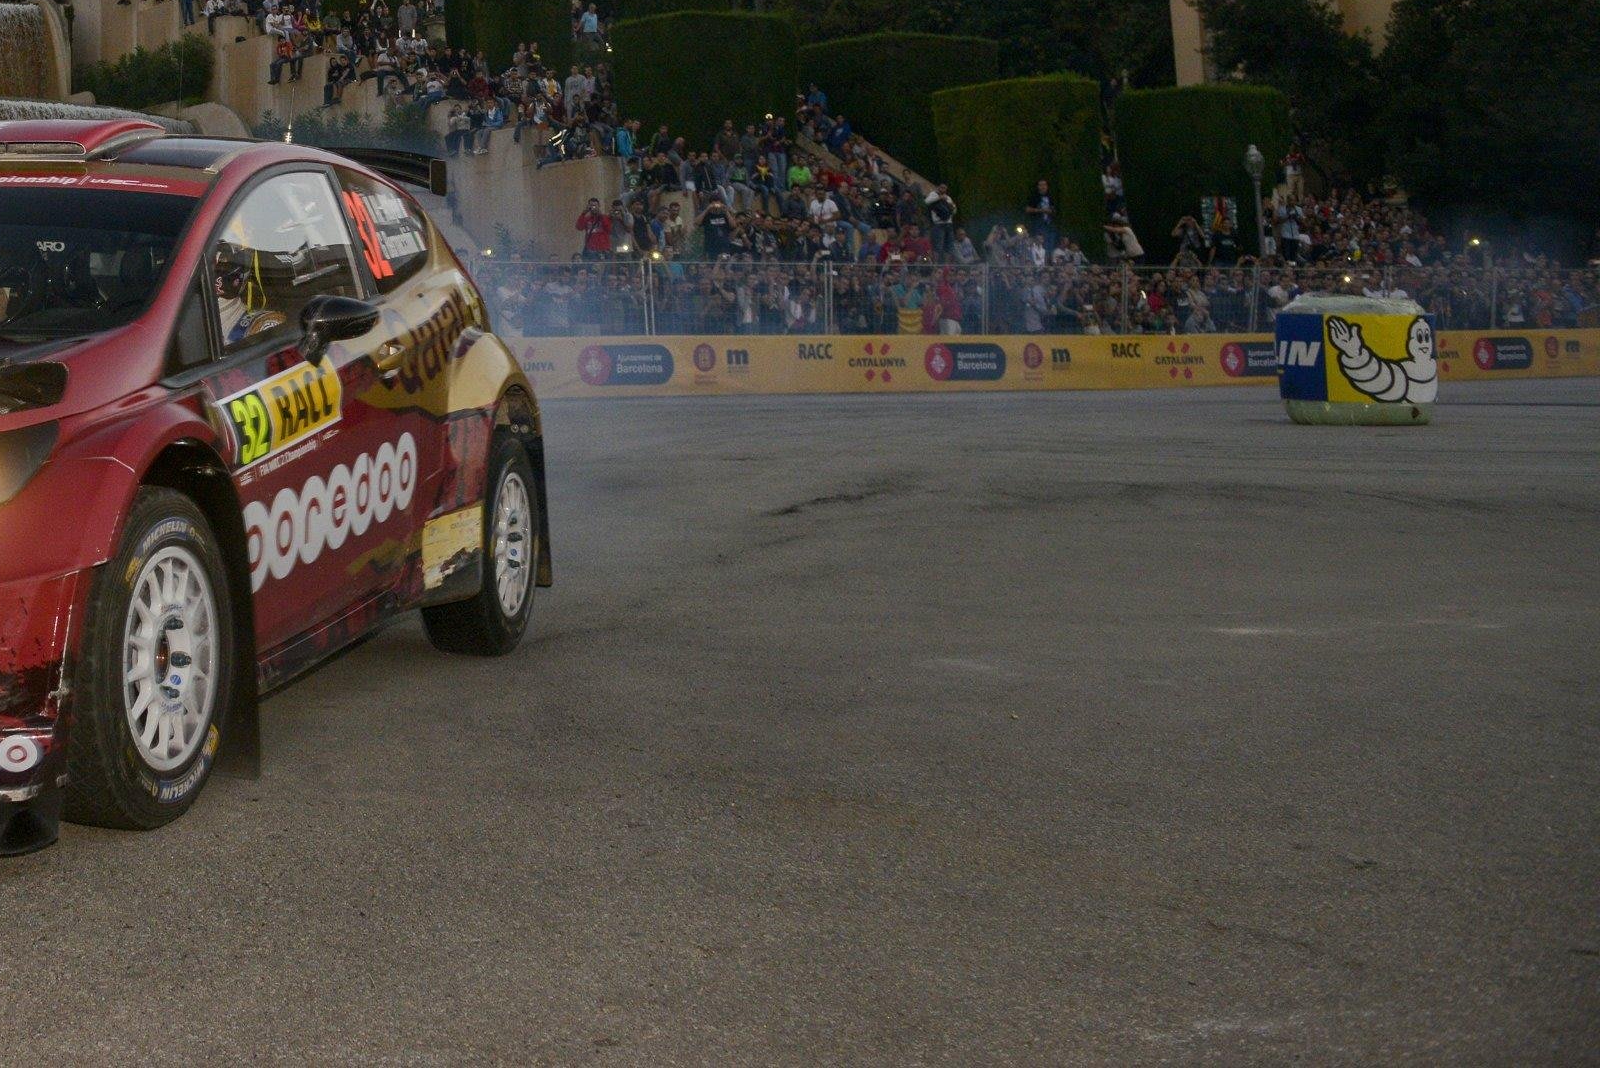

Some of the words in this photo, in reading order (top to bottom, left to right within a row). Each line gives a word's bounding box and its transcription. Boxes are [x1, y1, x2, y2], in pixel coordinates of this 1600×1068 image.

[797, 343, 833, 360] RACC
[1111, 342, 1141, 358] RACC
[848, 357, 906, 368] CATALUNYA
[957, 361, 997, 371] Barcelona
[1154, 356, 1205, 365] CATALUNYA
[617, 363, 663, 374] Barcelona
[231, 394, 270, 465] 32
[271, 365, 333, 441] RACC
